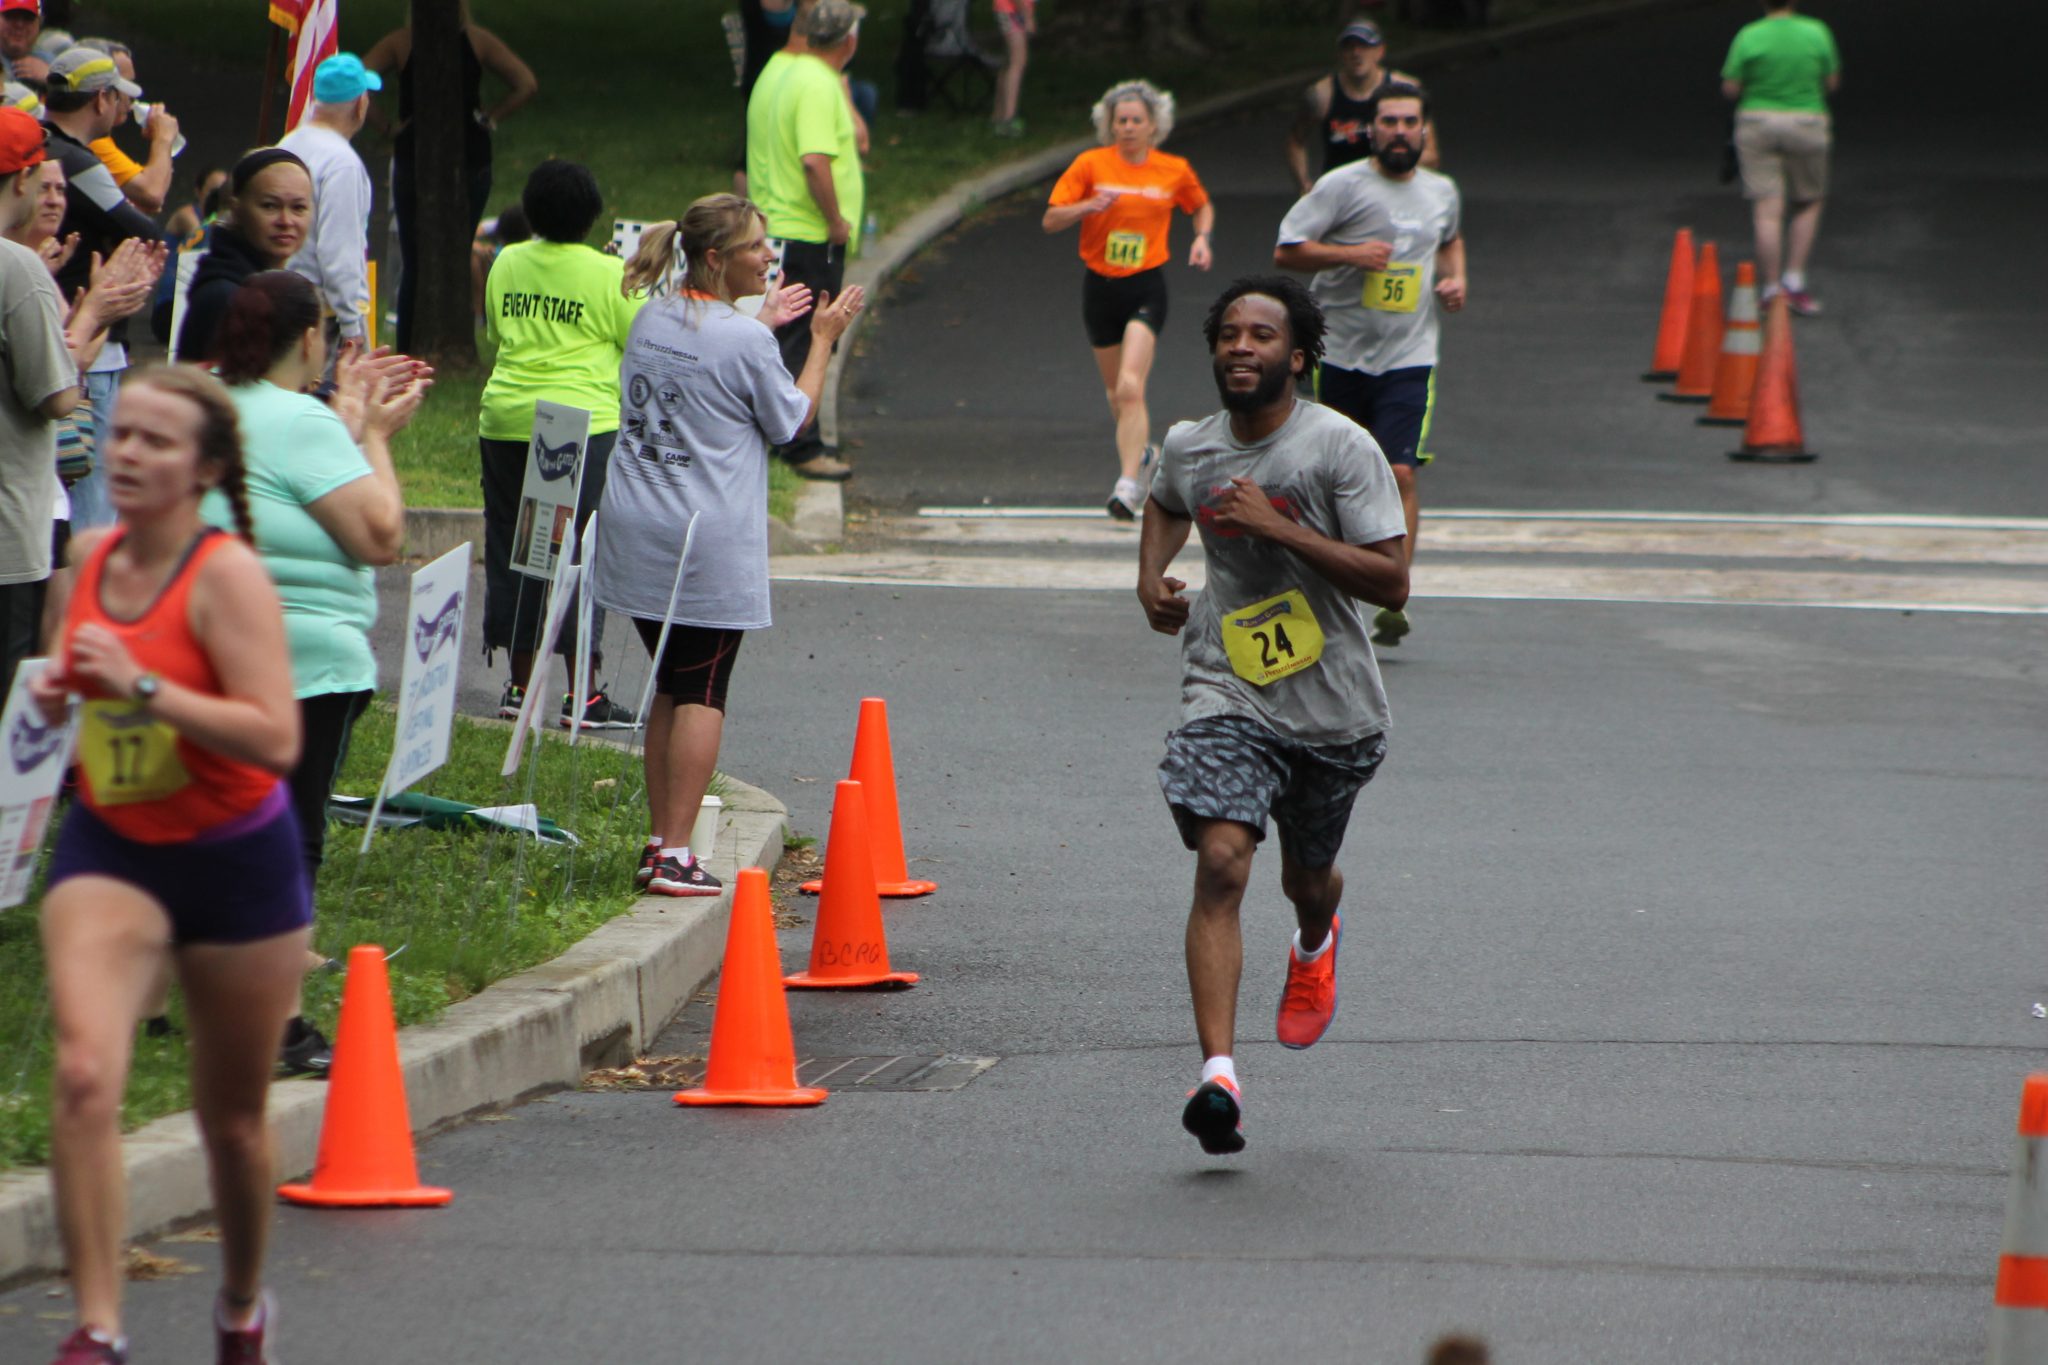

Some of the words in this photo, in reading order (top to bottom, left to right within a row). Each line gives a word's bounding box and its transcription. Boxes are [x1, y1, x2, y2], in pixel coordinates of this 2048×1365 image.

[1382, 279, 1405, 302] 56
[502, 293, 541, 318] EVENT
[543, 296, 584, 325] STAFF
[665, 452, 691, 463] CAMP
[1251, 622, 1295, 668] 24
[109, 734, 143, 785] 17
